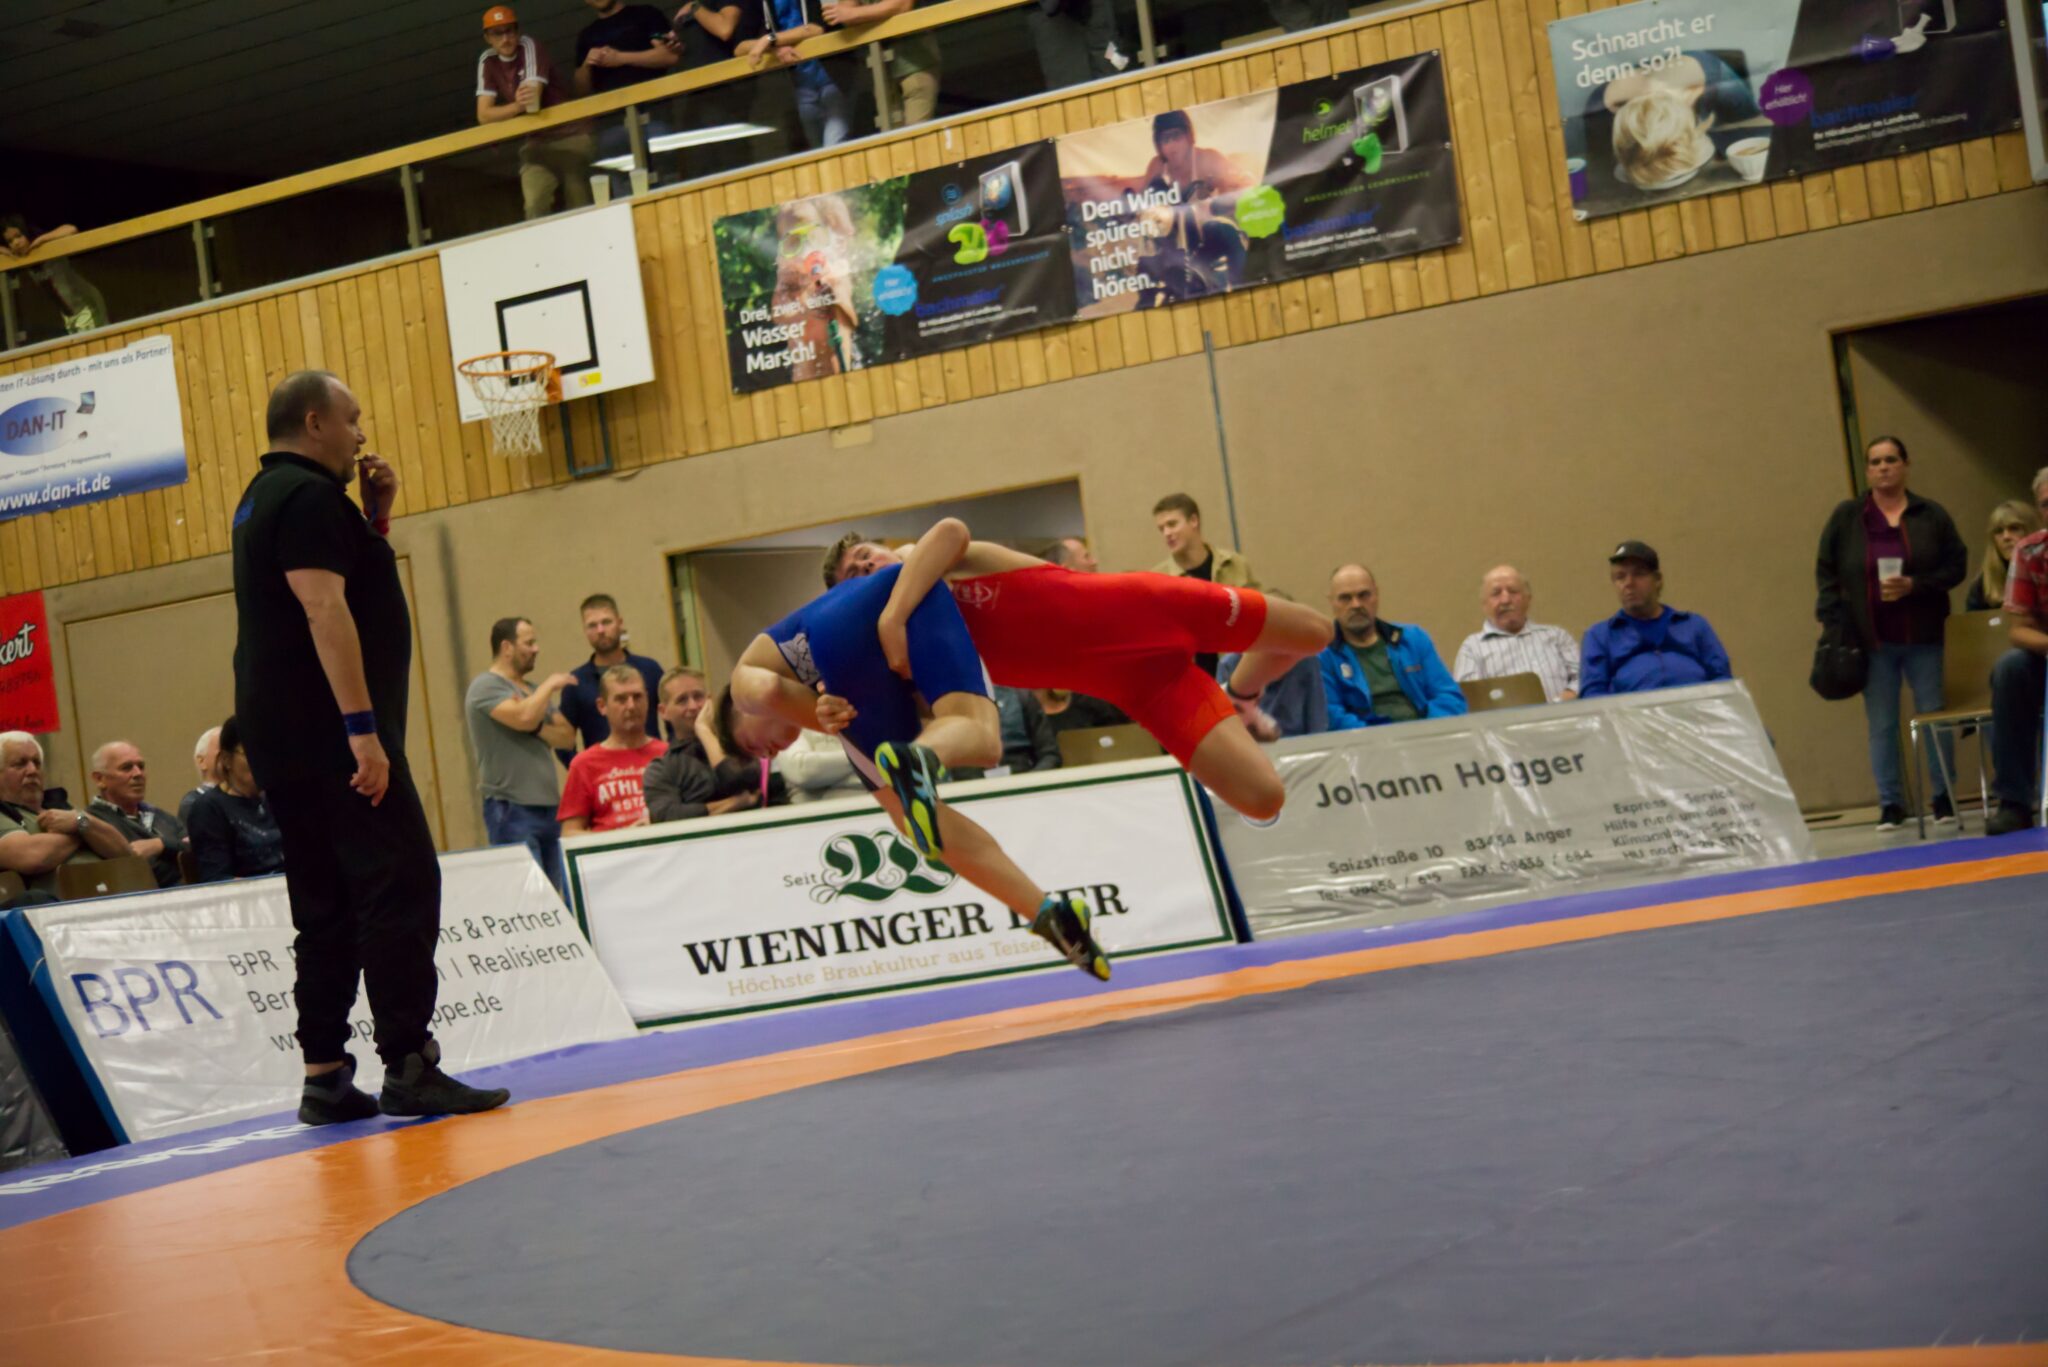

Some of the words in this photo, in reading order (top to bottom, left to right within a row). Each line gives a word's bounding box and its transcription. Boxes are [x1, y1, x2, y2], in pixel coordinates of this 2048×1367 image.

[1572, 19, 1685, 60] Schnarcht
[1690, 14, 1714, 34] er
[1576, 64, 1635, 88] denn
[1640, 45, 1683, 75] so?!
[1081, 200, 1123, 222] Den
[1127, 181, 1181, 212] Wind
[1086, 219, 1160, 249] spüren,
[1090, 245, 1139, 274] nicht
[1092, 273, 1156, 300] hören.
[739, 305, 773, 325] Drei,
[742, 320, 807, 349] Wasser
[0, 382, 15, 392] ten
[16, 371, 55, 389] IT-Lösung
[57, 365, 80, 379] durch
[88, 359, 102, 372] mit
[104, 358, 119, 369] uns
[121, 353, 134, 365] als
[135, 344, 171, 361] Partner!
[746, 340, 816, 374] Marsch!
[6, 410, 67, 440] DAN-IT
[0, 474, 111, 511] www.dan-it.de
[1316, 774, 1443, 808] Johann
[1455, 753, 1585, 788] Hogger
[1603, 820, 1638, 833] Hilfe
[1706, 804, 1727, 817] die
[1425, 845, 1444, 859] 10
[1524, 827, 1572, 845] Anger
[783, 873, 817, 887] Seit
[227, 949, 279, 977] BPR
[463, 917, 483, 940] &
[482, 909, 562, 936] Partner
[683, 902, 993, 975] WIENINGER
[468, 941, 584, 976] Realisieren
[728, 973, 815, 997] Höchste
[822, 952, 939, 983] Braukultur
[948, 944, 985, 965] aus
[71, 960, 224, 1038] BPR
